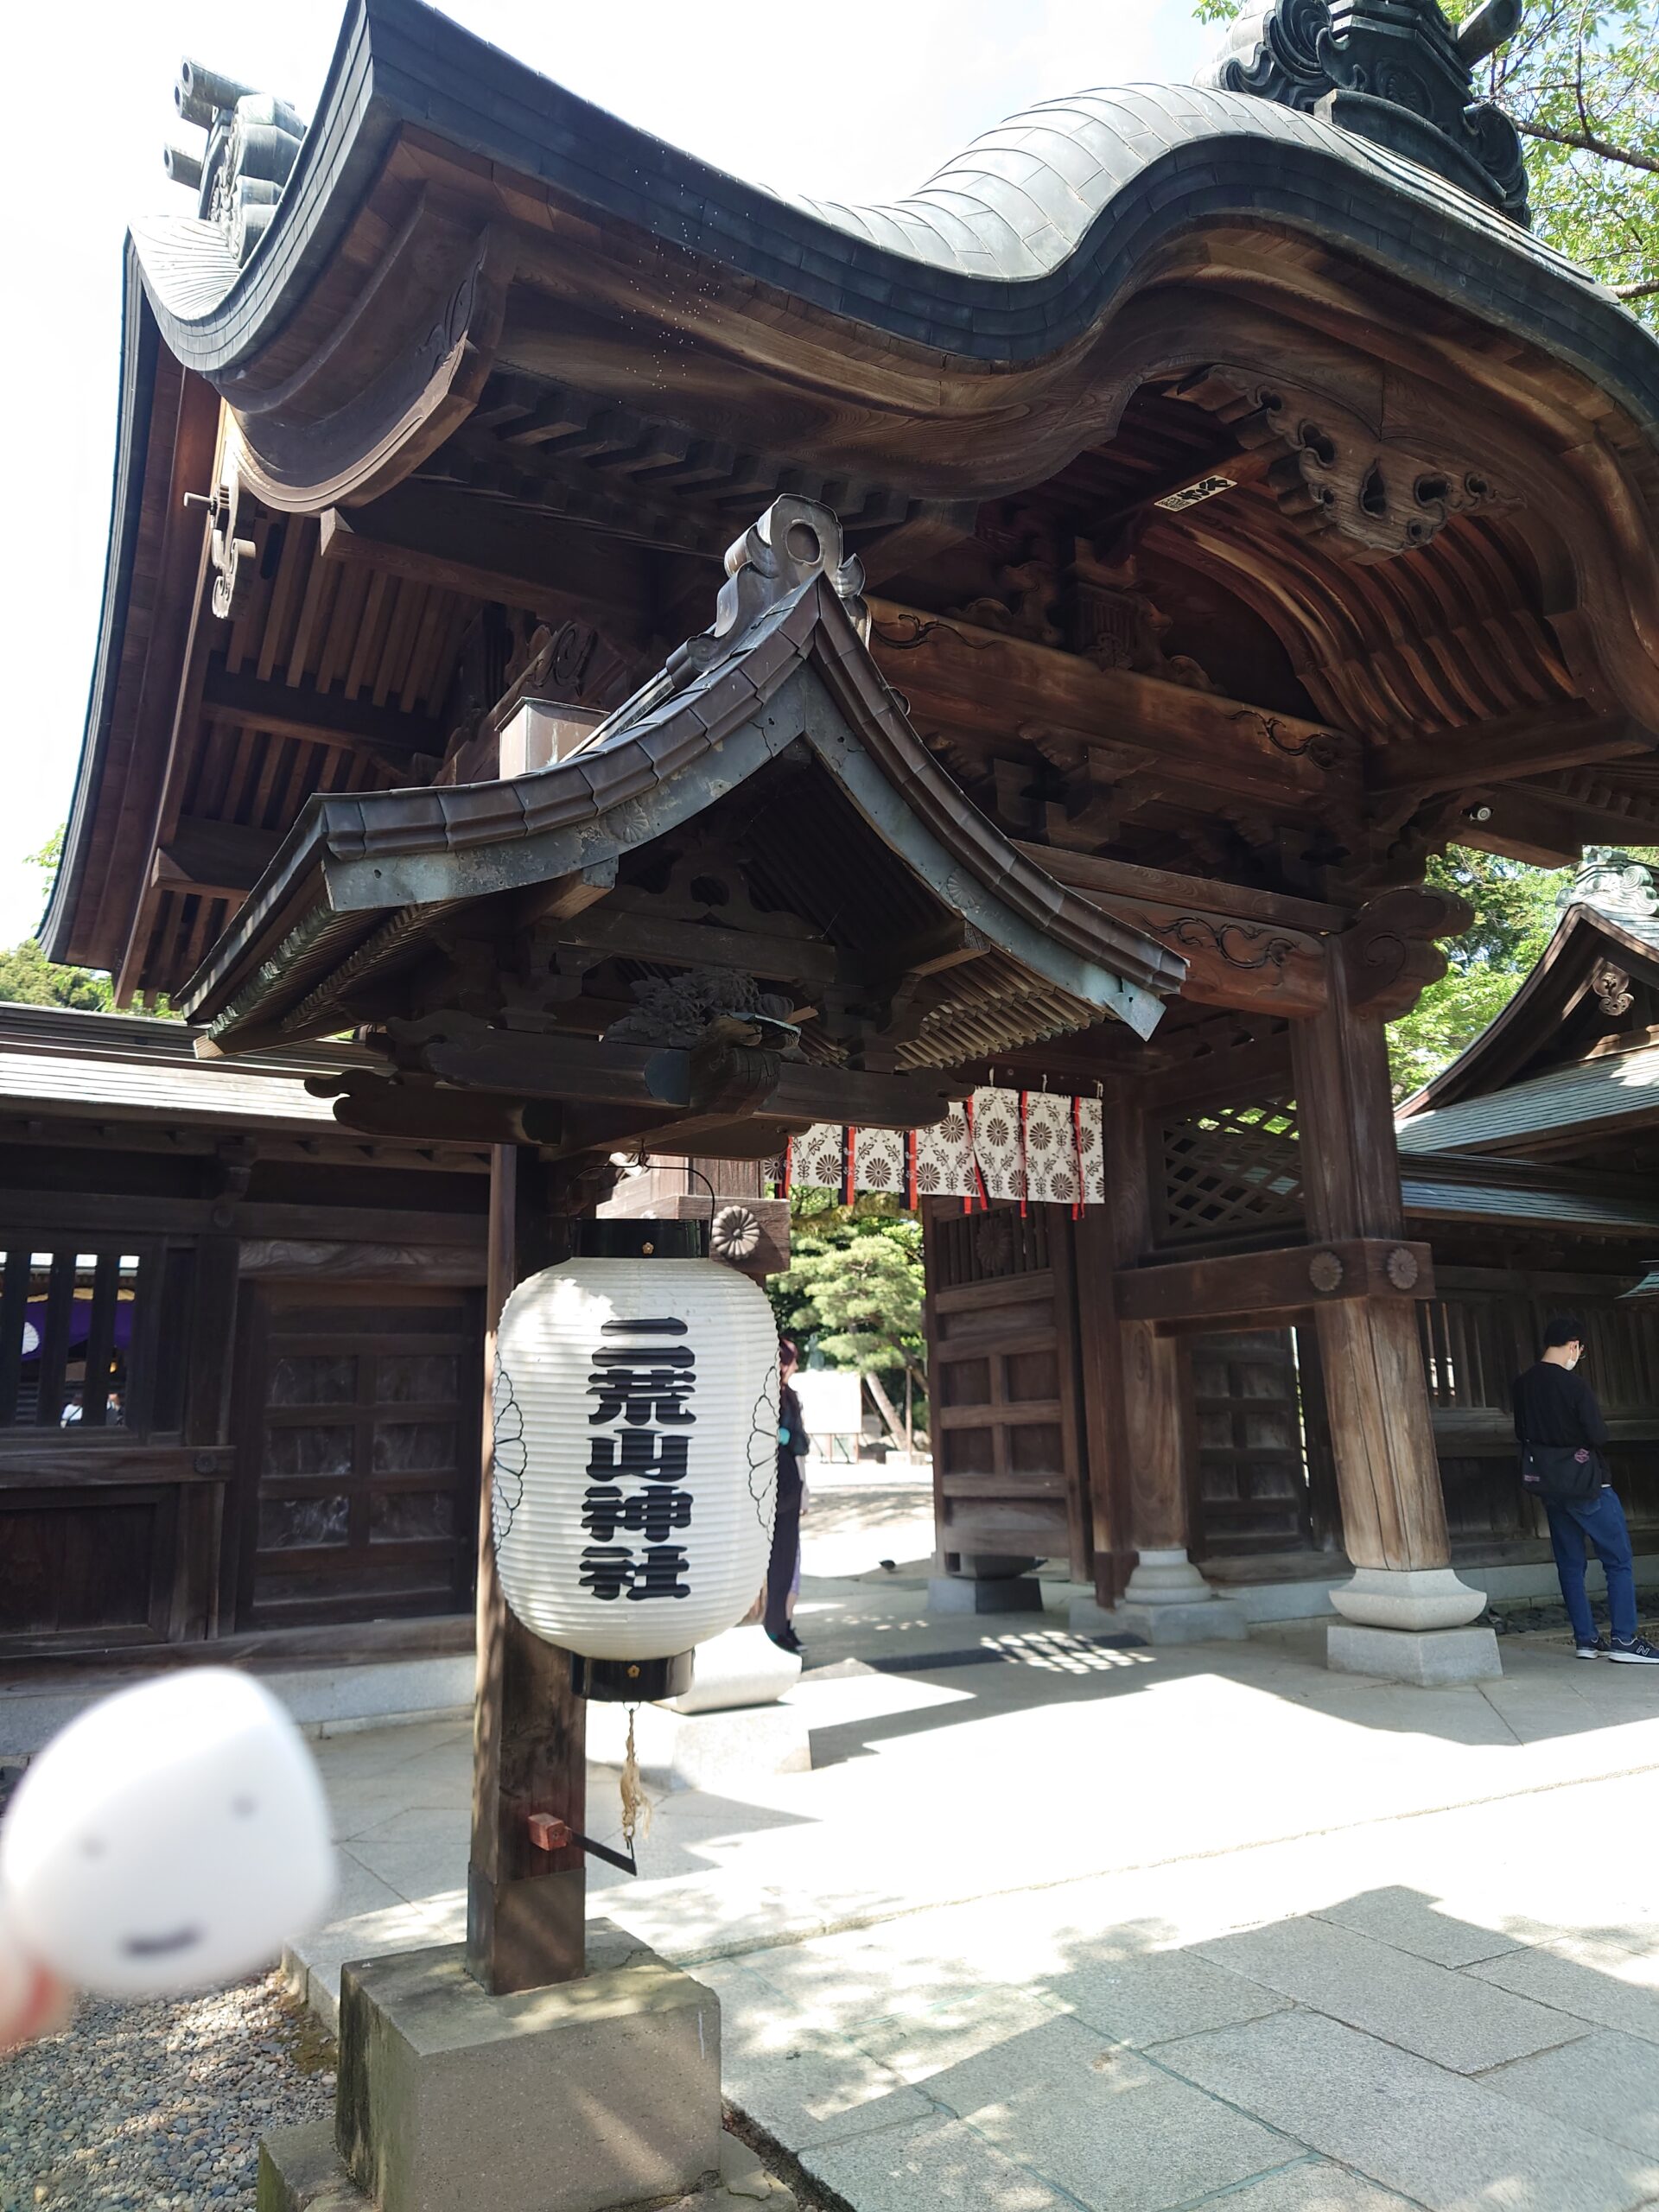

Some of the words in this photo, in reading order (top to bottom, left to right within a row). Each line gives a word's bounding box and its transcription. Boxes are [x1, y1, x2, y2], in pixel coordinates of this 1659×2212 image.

[579, 1317, 696, 1601] 二荒山神社
[1636, 1645, 1650, 1656] N
